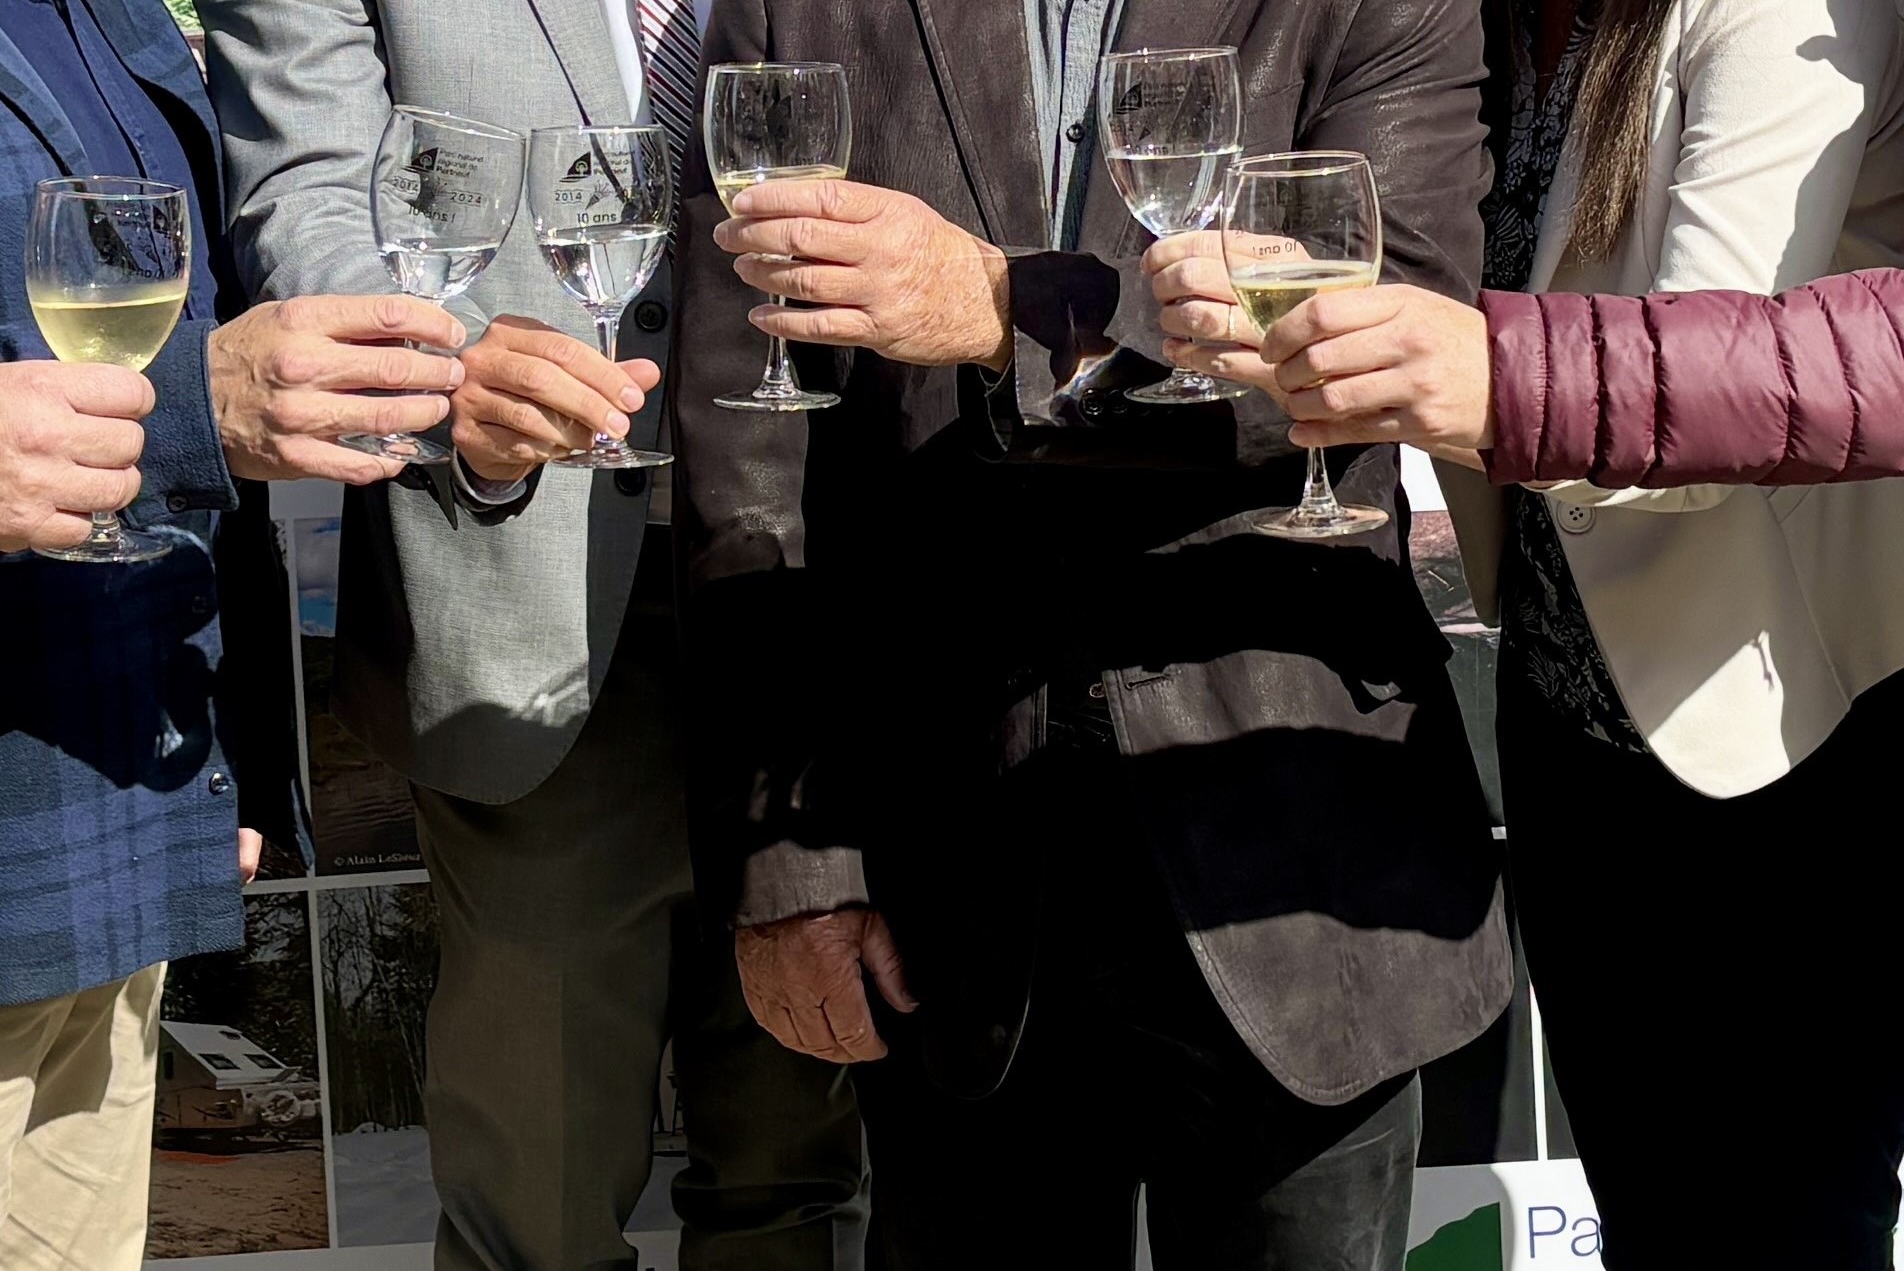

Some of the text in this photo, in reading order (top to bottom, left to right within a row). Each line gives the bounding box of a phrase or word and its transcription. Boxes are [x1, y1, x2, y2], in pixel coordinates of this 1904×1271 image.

[555, 192, 582, 202] 2014
[577, 212, 616, 224] 10 ans
